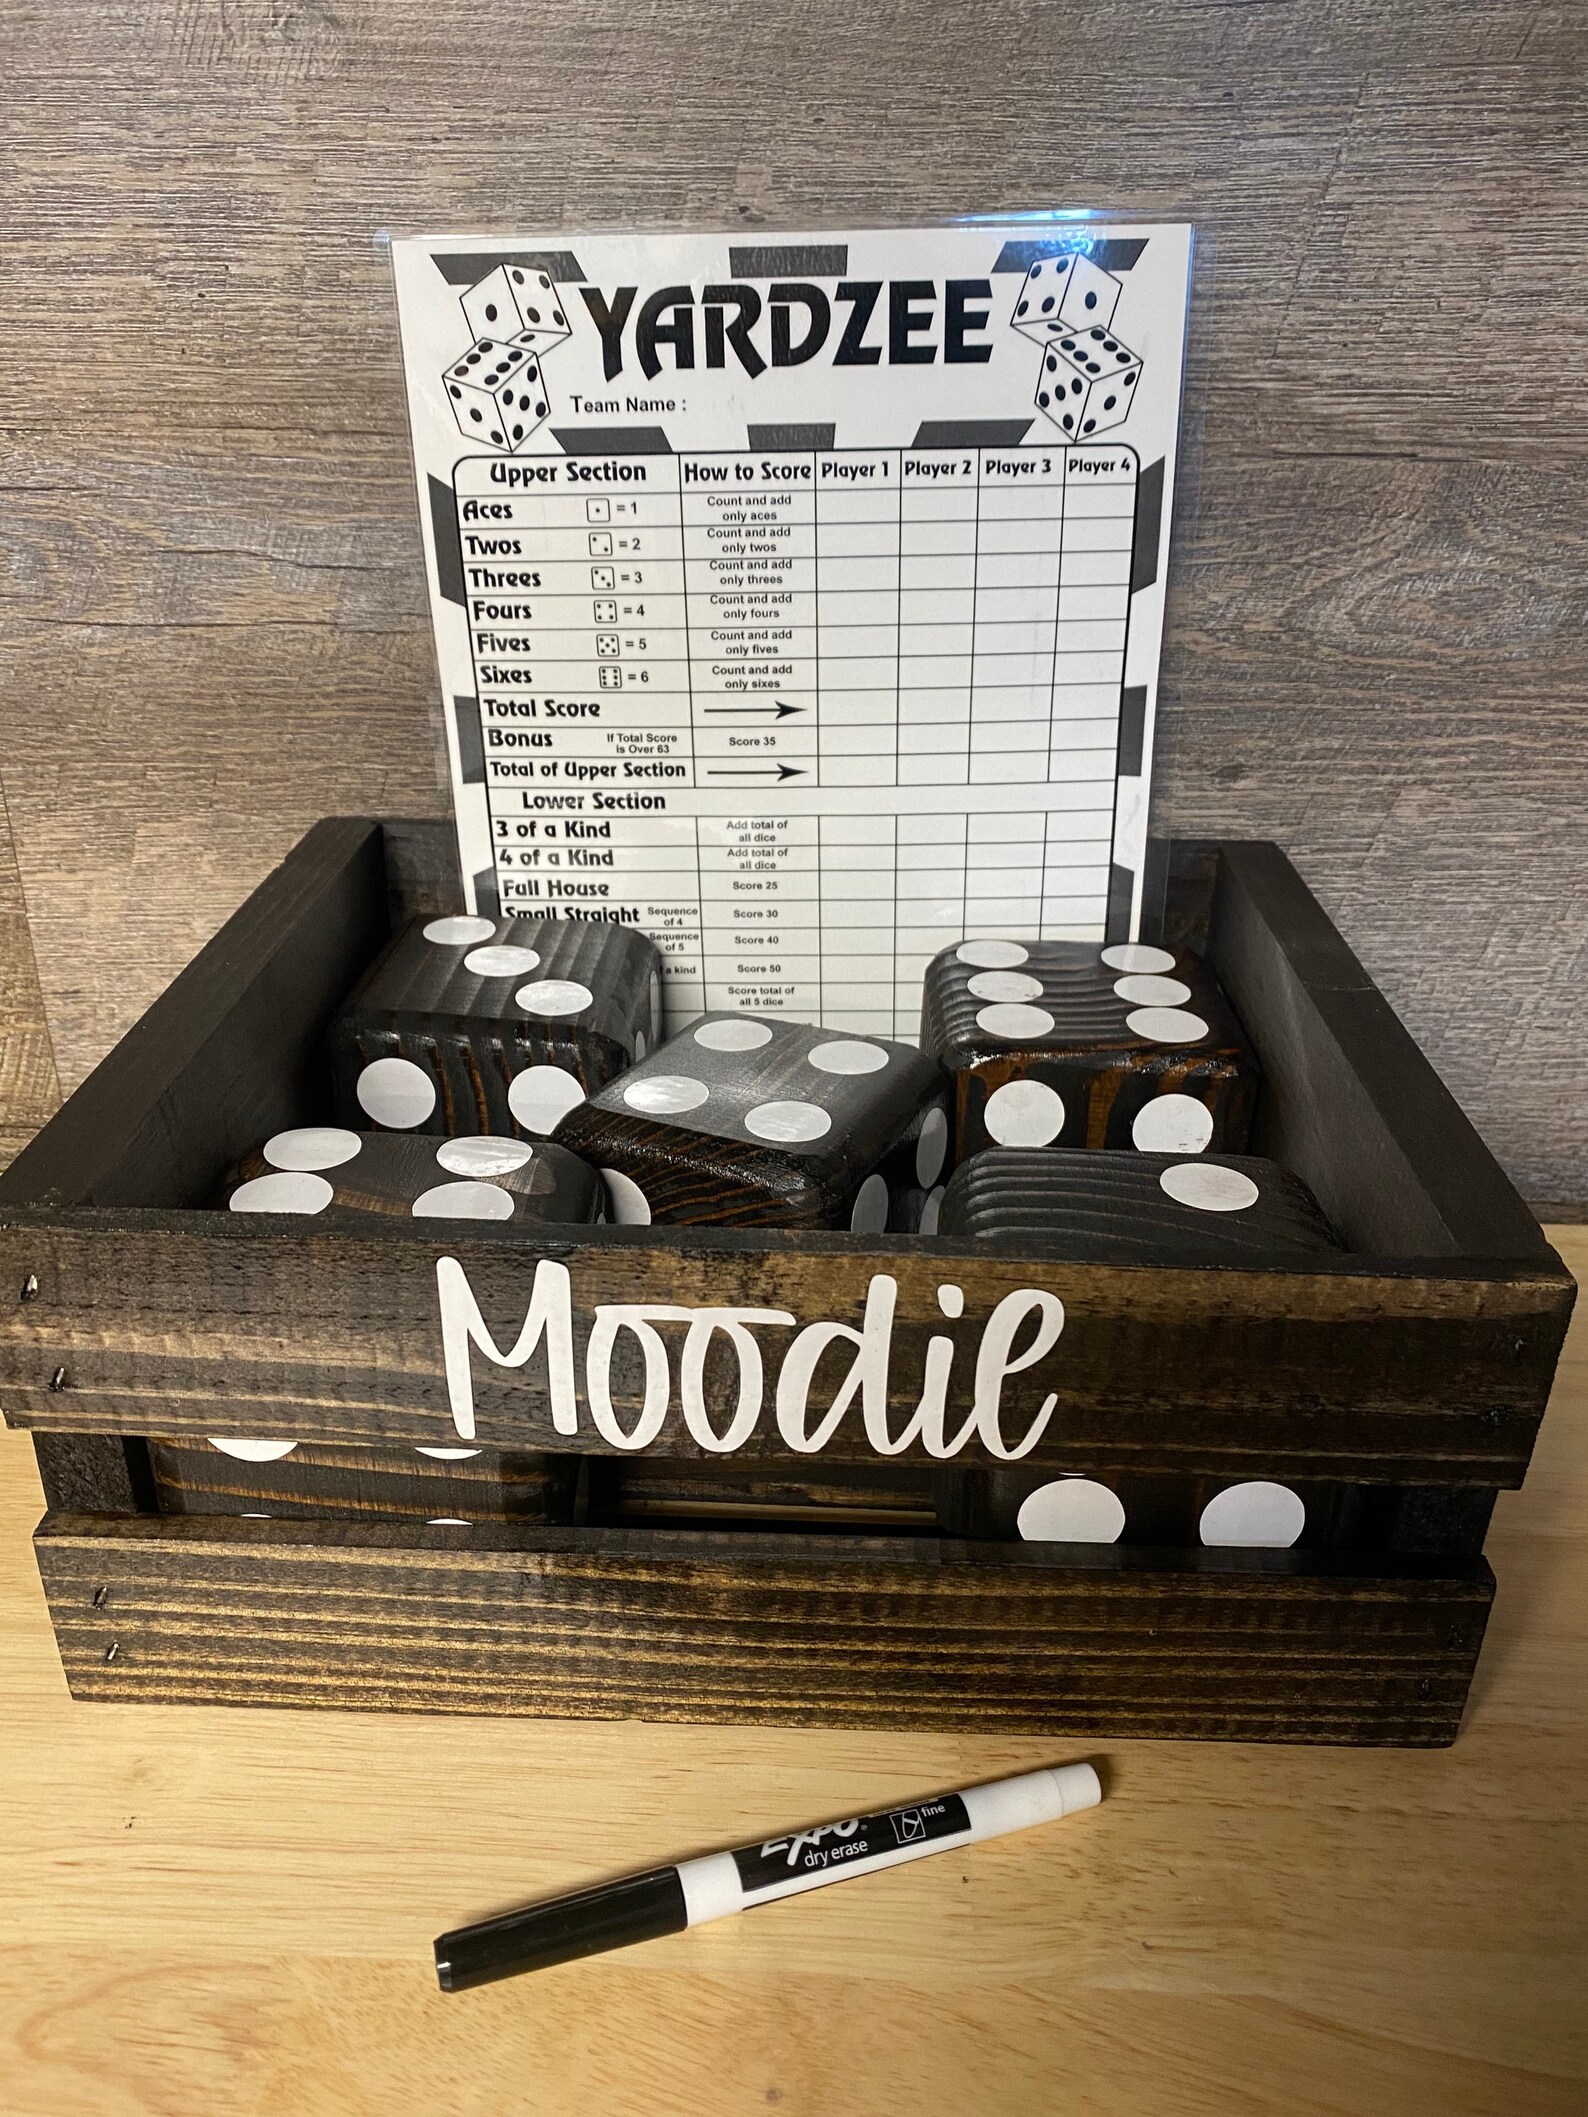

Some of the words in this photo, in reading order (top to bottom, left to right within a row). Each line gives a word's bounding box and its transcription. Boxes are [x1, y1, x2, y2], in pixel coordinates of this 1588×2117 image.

[577, 277, 993, 383] YARDZEE
[570, 395, 620, 413] Team
[626, 397, 675, 412] Name
[822, 462, 876, 480] Player
[882, 461, 888, 477] 1
[905, 461, 957, 479] Player
[962, 460, 971, 474] 2
[986, 460, 1036, 477] Player
[1042, 459, 1051, 473] 3
[1069, 459, 1115, 475] Player
[1121, 458, 1130, 471] 4
[490, 463, 557, 488] Upper
[566, 461, 646, 482] Section
[684, 463, 728, 484] How
[735, 463, 754, 481] to
[761, 462, 811, 480] Score
[707, 496, 742, 506] Count
[745, 495, 767, 505] and
[770, 495, 791, 505] add
[463, 500, 513, 522] Aces
[631, 502, 637, 514] 1
[722, 511, 747, 523] only
[750, 512, 777, 520] aces
[707, 528, 742, 538] Count
[745, 527, 766, 537] and
[770, 526, 791, 537] add
[465, 536, 522, 555] Twos
[632, 538, 640, 550] 2
[722, 542, 746, 555] only
[750, 543, 776, 552] twos
[708, 558, 745, 570] Count
[745, 557, 769, 570] and
[770, 557, 794, 569] add
[468, 568, 541, 587] Threes
[635, 571, 642, 584] 3
[720, 575, 744, 587] only
[747, 574, 783, 584] threes
[710, 594, 744, 605] Count
[747, 594, 768, 604] and
[771, 594, 792, 603] add
[473, 601, 532, 621] Fours
[637, 604, 645, 616] 4
[723, 609, 747, 621] only
[750, 608, 780, 618] fours
[711, 631, 745, 640] Count
[748, 630, 768, 640] and
[772, 630, 792, 639] add
[477, 633, 531, 654] Fives
[639, 638, 647, 650] 5
[725, 645, 749, 656] only
[752, 644, 779, 654] fives
[480, 665, 532, 683] Sixes
[712, 665, 746, 675] Count
[748, 665, 769, 674] and
[772, 665, 792, 674] add
[641, 671, 649, 683] 6
[723, 679, 750, 693] only
[752, 679, 780, 688] sixes
[483, 699, 536, 717] Total
[544, 699, 600, 717] Score
[488, 729, 553, 747] Bonus
[607, 733, 614, 742] If
[617, 733, 643, 742] Total
[648, 733, 677, 743] Score
[729, 737, 760, 746] Score
[764, 736, 776, 746] 35
[616, 744, 625, 754] is
[628, 744, 654, 754] Over
[657, 744, 670, 753] 63
[490, 761, 534, 777] Total
[540, 762, 558, 777] of
[564, 761, 617, 784] Upper
[623, 762, 686, 777] Section
[522, 791, 584, 809] Lower
[592, 792, 666, 809] Section
[496, 820, 508, 837] 3
[516, 821, 536, 837] of
[544, 825, 556, 837] a
[565, 821, 611, 838] Kind
[726, 820, 748, 830] Add
[751, 820, 774, 829] total
[777, 820, 788, 829] of
[739, 833, 751, 842] all
[754, 833, 776, 842] dice
[499, 850, 513, 865] 4
[520, 849, 540, 866] of
[548, 853, 560, 865] a
[568, 849, 614, 866] Kind
[727, 848, 748, 857] Add
[751, 848, 774, 857] total
[777, 848, 788, 857] of
[739, 861, 752, 869] all
[754, 861, 776, 870] dice
[503, 880, 539, 897] Full
[547, 880, 609, 898] House
[733, 881, 763, 890] Score
[766, 881, 778, 890] 25
[647, 907, 698, 917] Sequence
[733, 909, 763, 918] Score
[766, 909, 778, 918] 30
[664, 918, 674, 926] of
[648, 932, 699, 943] Sequence
[735, 936, 764, 944] Score
[767, 936, 779, 944] 40
[665, 943, 675, 951] of
[678, 943, 684, 951] 5
[674, 966, 696, 974] kind
[737, 964, 767, 973] Score
[770, 964, 781, 973] 50
[728, 986, 757, 995] Score
[785, 986, 795, 994] of
[754, 998, 760, 1006] 5
[762, 998, 784, 1006] dice
[435, 1255, 1066, 1461] Moodie
[920, 1805, 946, 1817] fine
[804, 1850, 828, 1868] dry
[831, 1840, 868, 1859] erase
